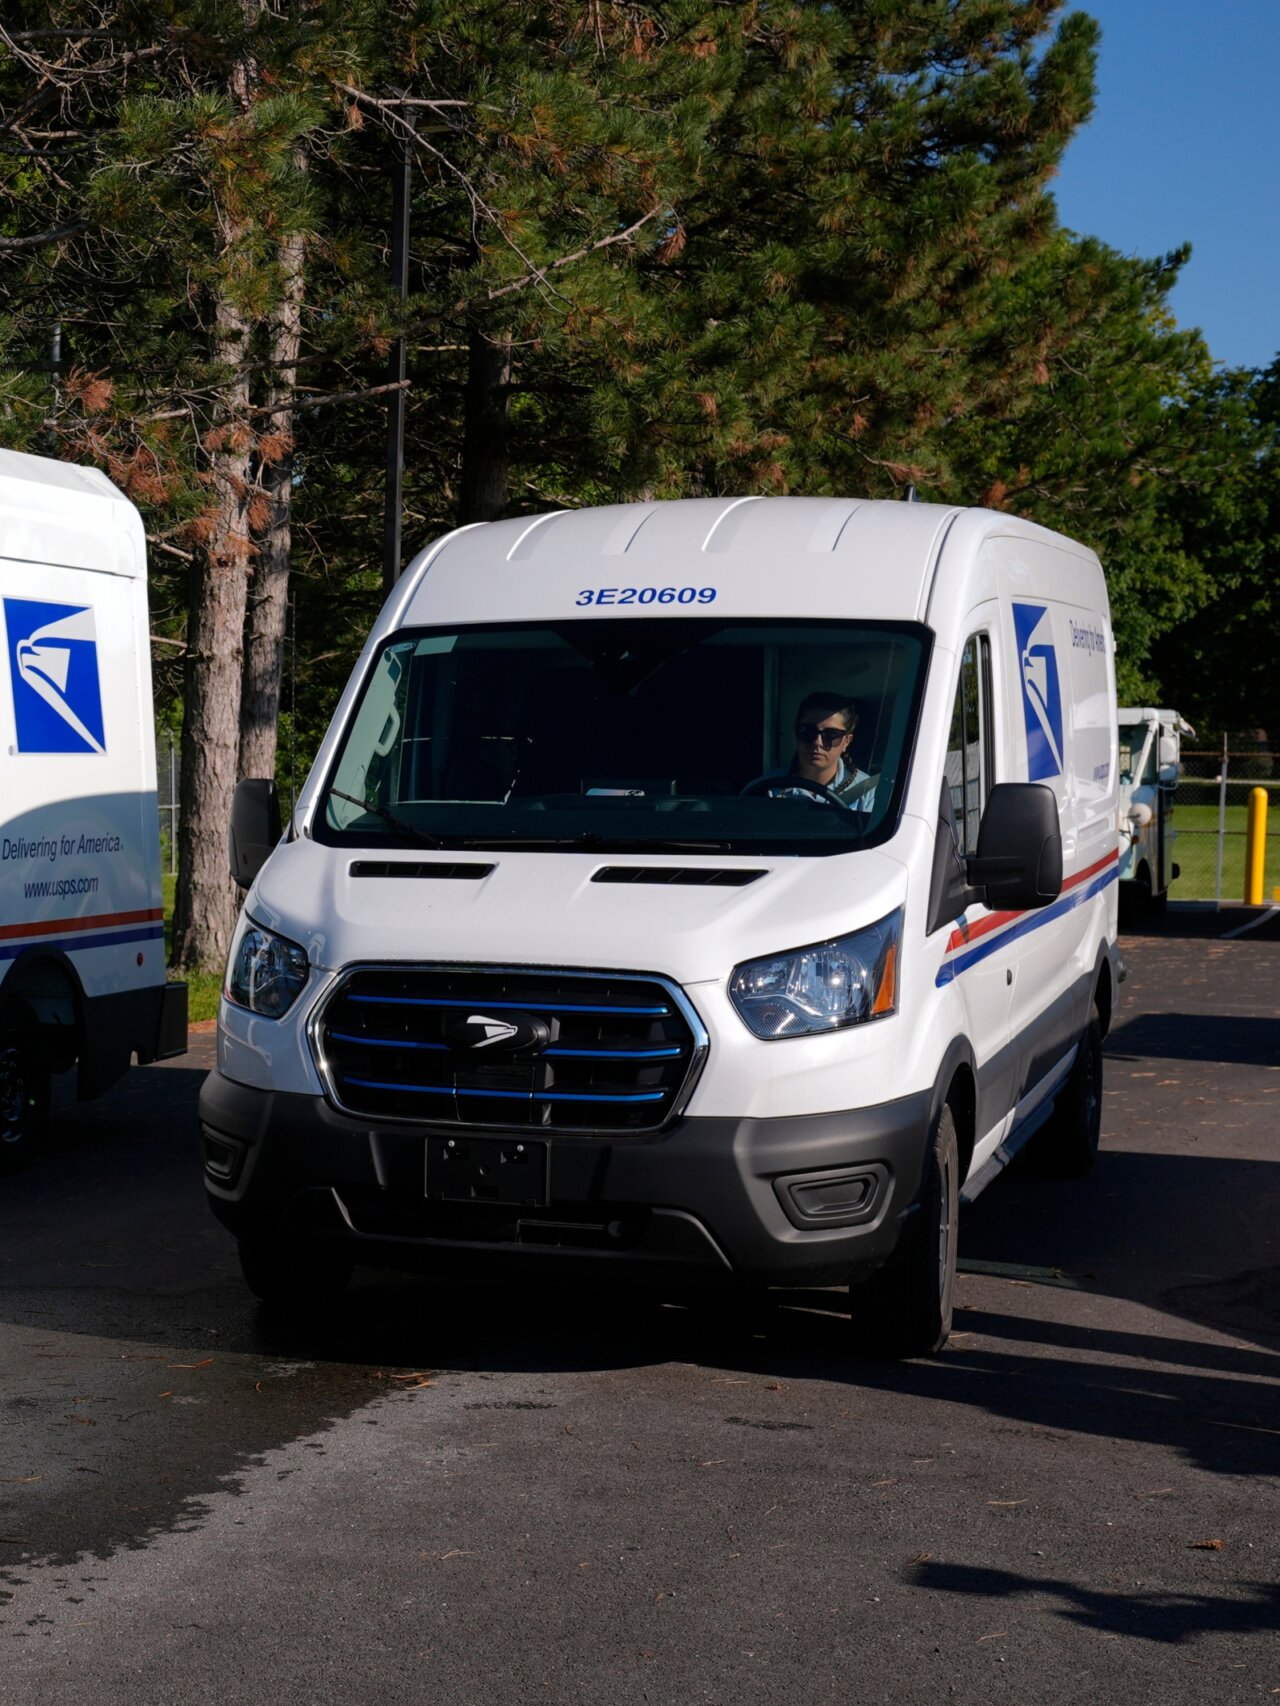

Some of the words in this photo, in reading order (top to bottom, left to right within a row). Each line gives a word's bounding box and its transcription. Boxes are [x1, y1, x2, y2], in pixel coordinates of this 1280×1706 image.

[575, 587, 717, 606] 3E20609
[2, 837, 57, 862] Delivering
[60, 834, 75, 856] for
[24, 876, 99, 900] www.usps.com
